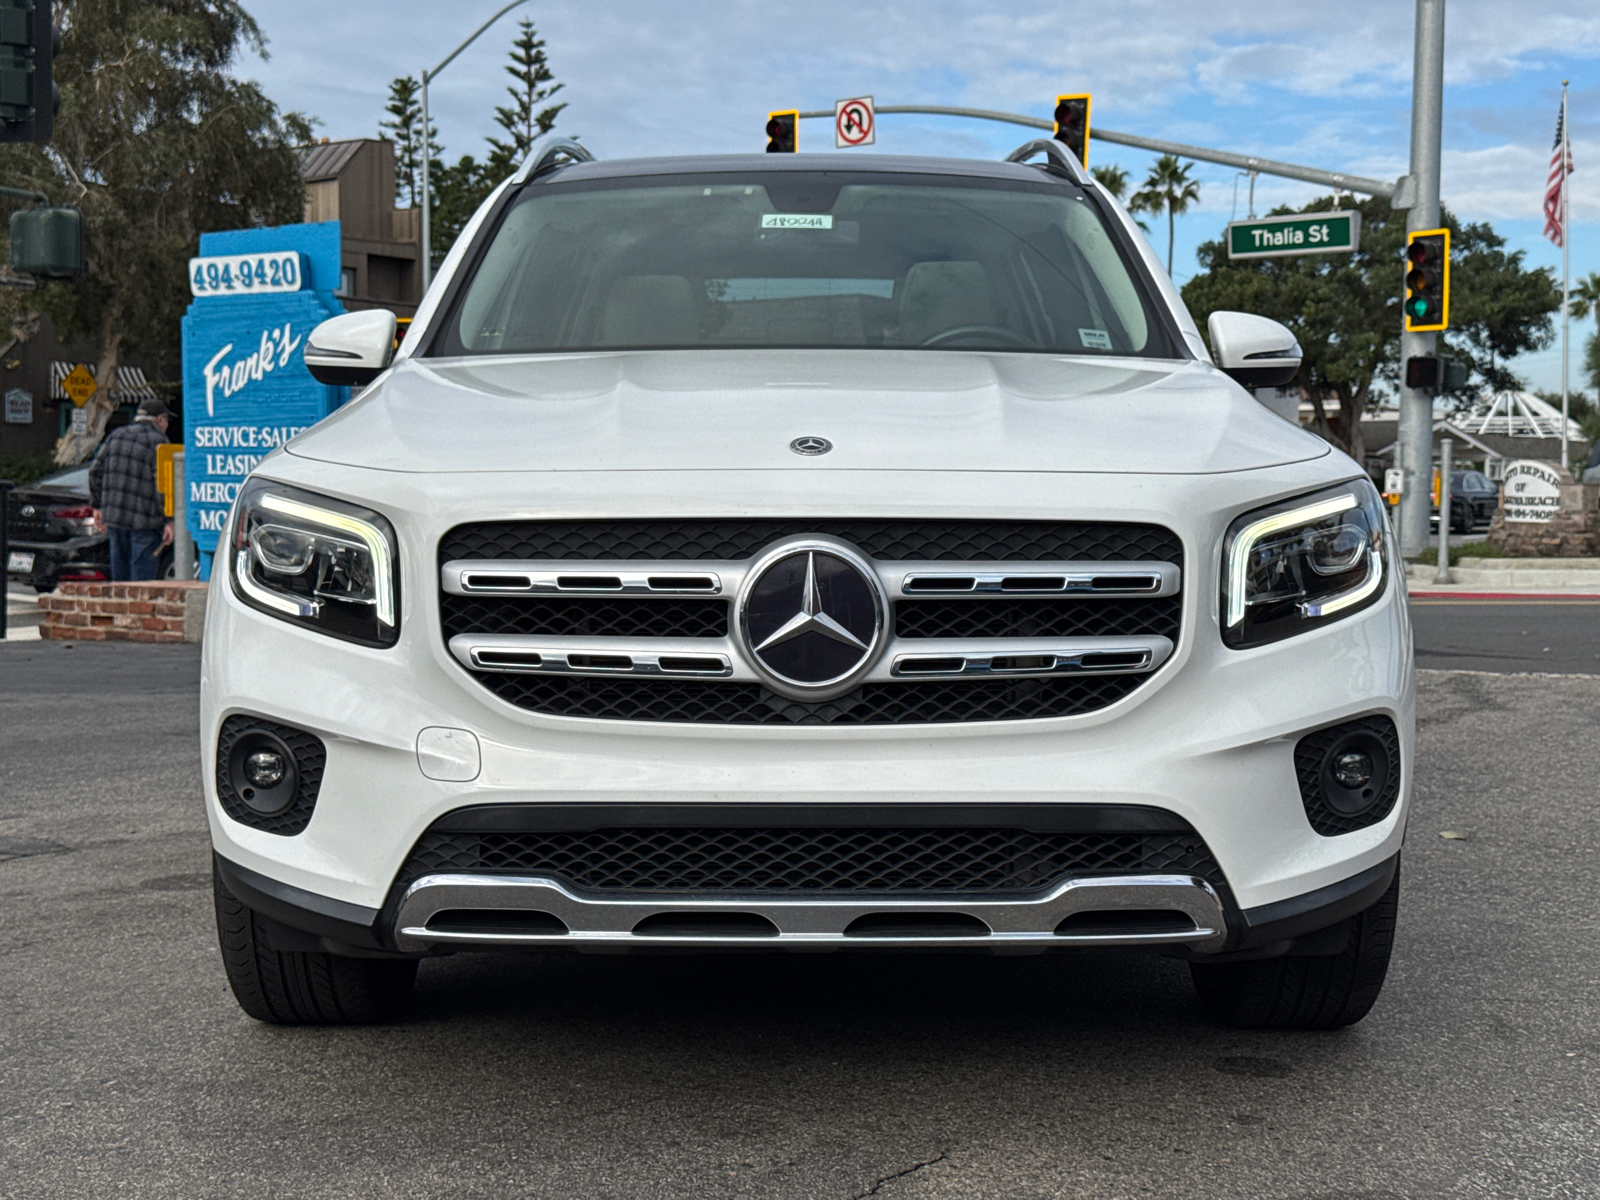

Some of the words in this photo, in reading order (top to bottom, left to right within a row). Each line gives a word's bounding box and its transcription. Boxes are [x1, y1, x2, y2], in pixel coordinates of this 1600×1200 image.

[1251, 226, 1304, 247] Thalia
[1308, 224, 1330, 243] St
[203, 322, 302, 418] Frank's
[70, 376, 91, 386] DEAD
[72, 388, 89, 397] END
[206, 454, 262, 476] LEASIN
[1514, 482, 1527, 493] OF
